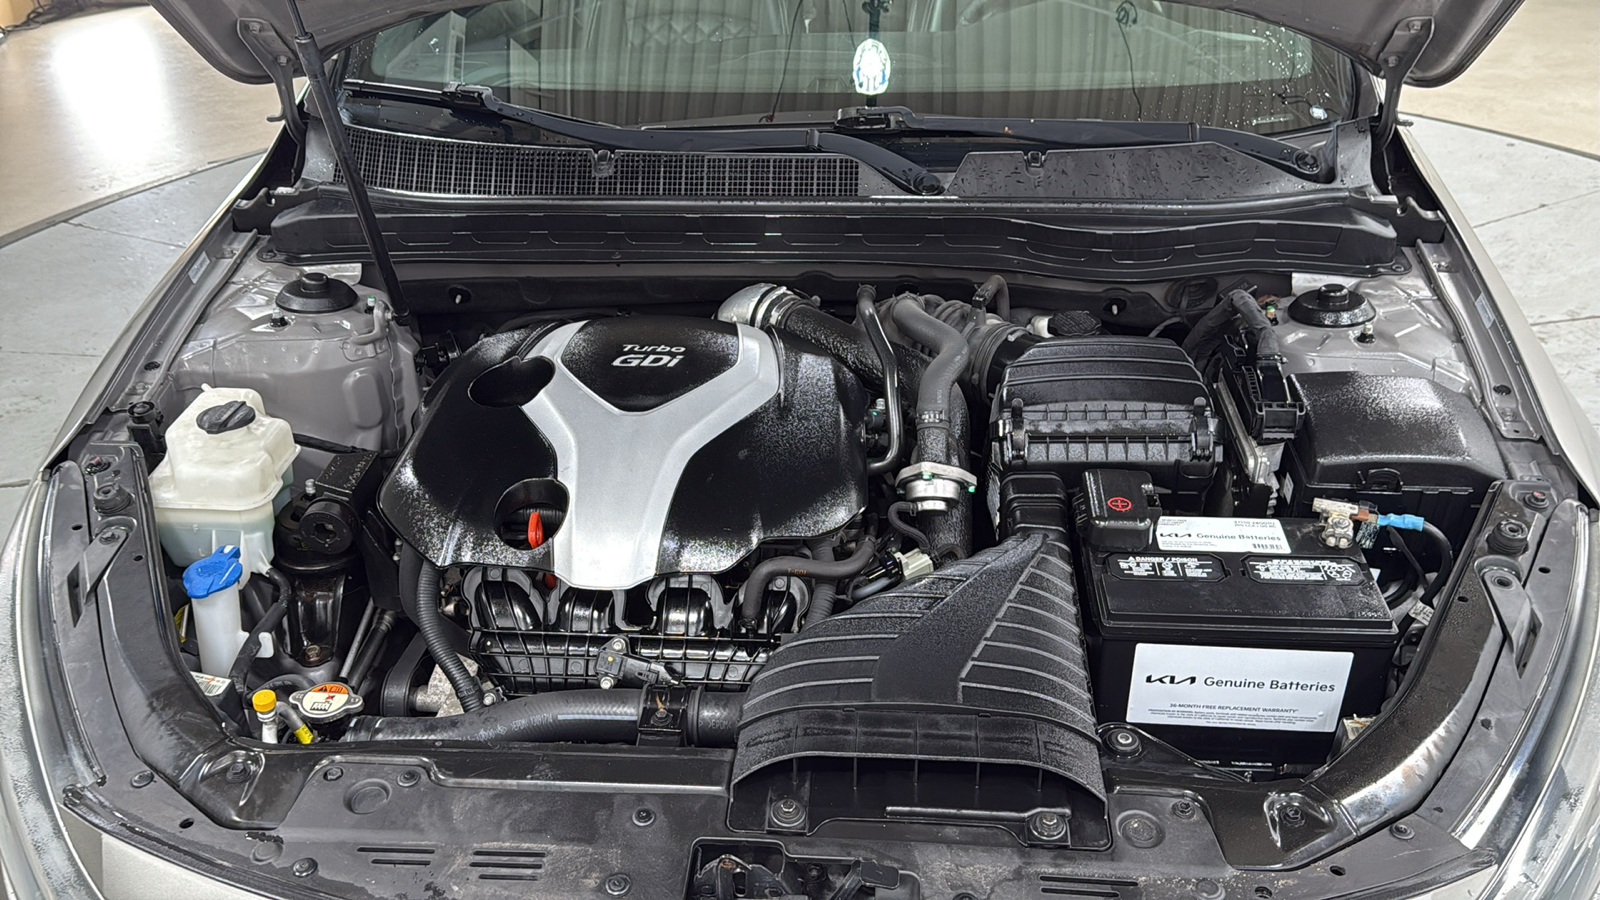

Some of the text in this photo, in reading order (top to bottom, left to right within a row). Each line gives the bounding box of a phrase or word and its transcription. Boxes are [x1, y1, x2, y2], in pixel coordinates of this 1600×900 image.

[623, 344, 686, 352] Turbo
[611, 354, 685, 367] GDi
[1145, 674, 1336, 692] KIA Genuine Batteries
[1218, 705, 1262, 713] REPLACEMENT
